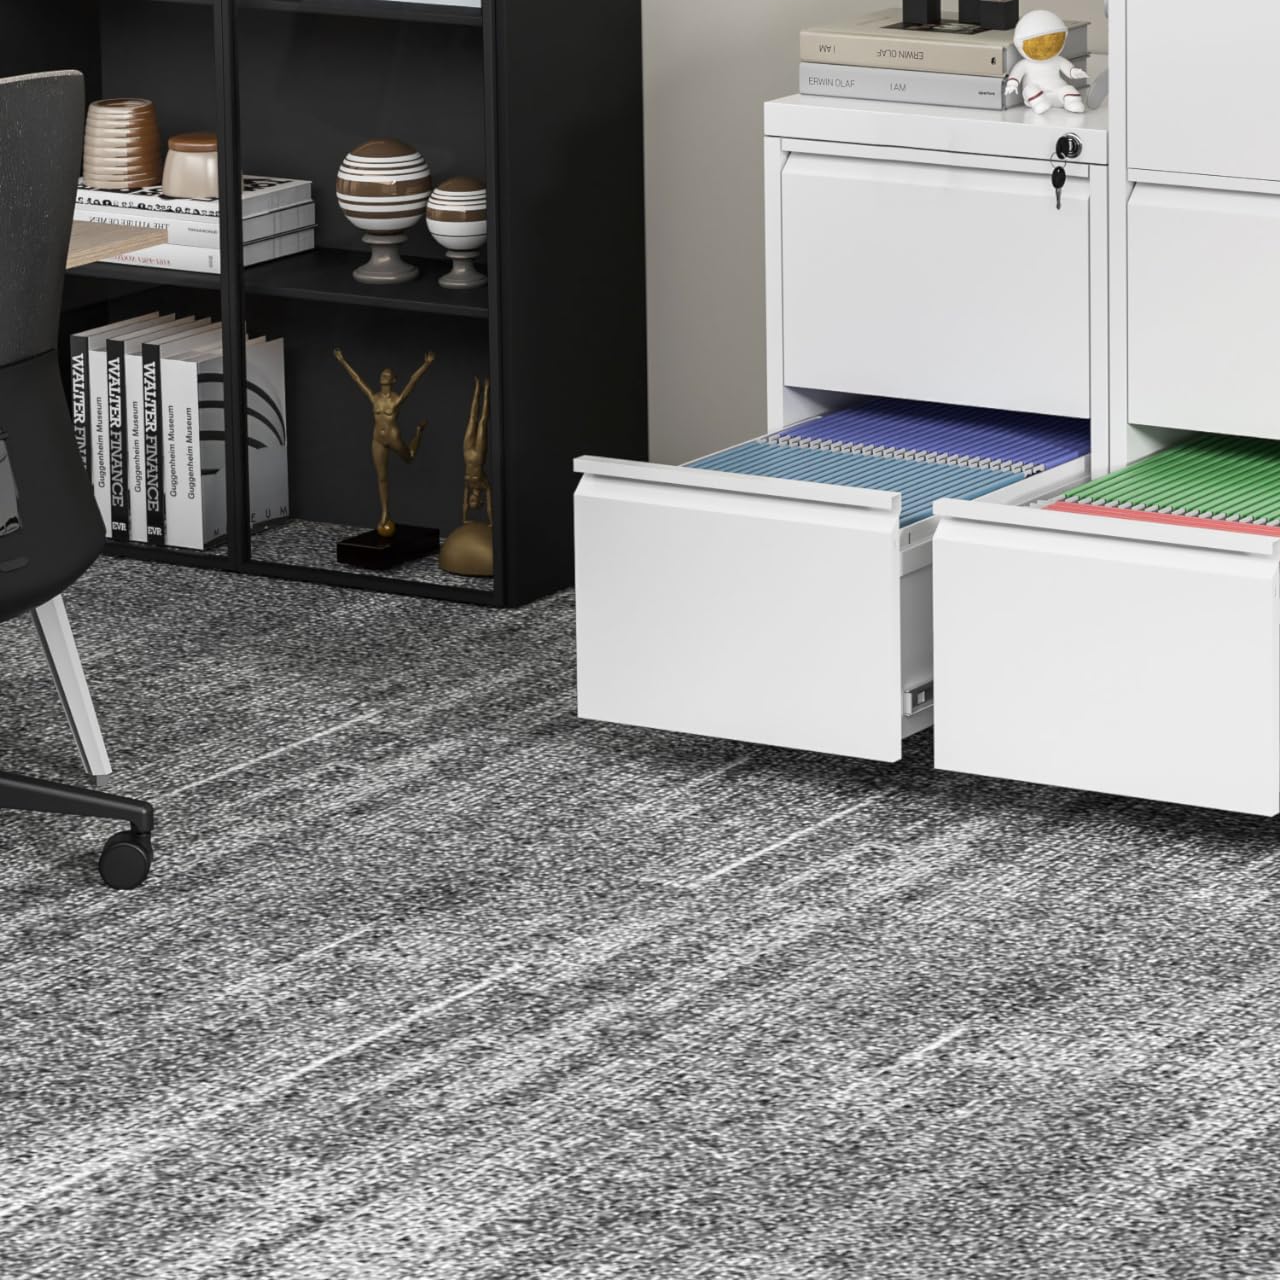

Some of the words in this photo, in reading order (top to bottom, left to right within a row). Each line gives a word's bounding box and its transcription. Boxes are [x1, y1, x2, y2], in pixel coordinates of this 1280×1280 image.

[819, 44, 832, 54] AM
[877, 48, 897, 59] OLAF
[898, 50, 924, 60] ERWIN
[808, 76, 834, 88] ERWIN
[835, 78, 855, 89] OLAF
[894, 83, 907, 92] AM
[71, 353, 85, 424] WALTER
[108, 357, 122, 428] WALTER
[143, 361, 157, 433] WALTER
[98, 435, 106, 488] Guggenheim
[110, 430, 124, 508] FINANCE
[134, 439, 142, 493] Guggenheim
[145, 434, 159, 512] FINANCE
[169, 443, 178, 497] Guggenheim
[187, 445, 196, 500] Guggenheim
